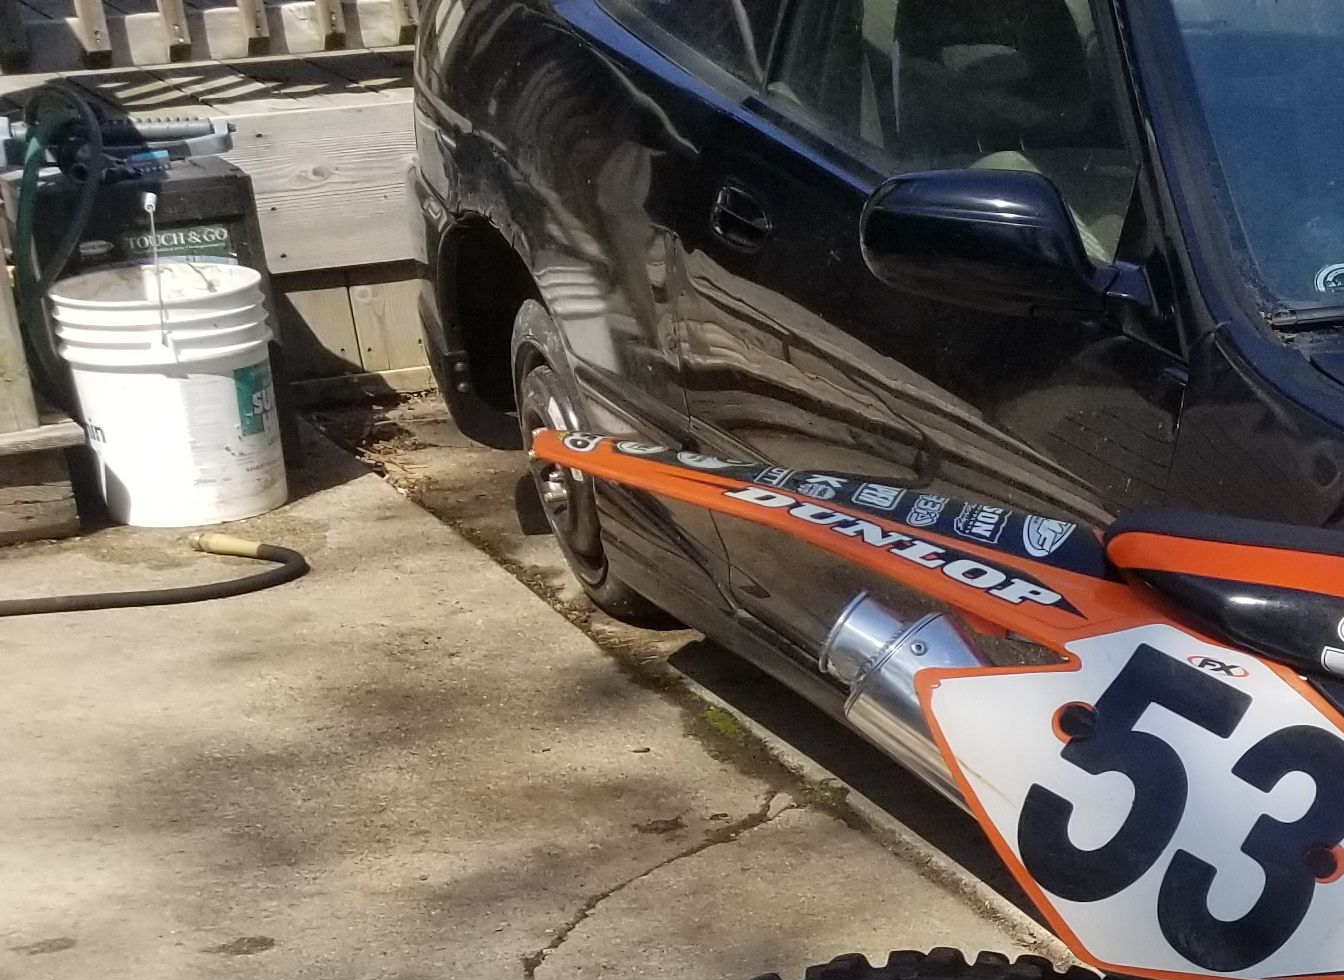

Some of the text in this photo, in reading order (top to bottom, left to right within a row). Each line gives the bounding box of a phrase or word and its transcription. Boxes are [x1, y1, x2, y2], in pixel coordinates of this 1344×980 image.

[188, 230, 201, 244] &
[202, 227, 228, 242] GO
[722, 486, 1063, 606] DUNLOP
[1198, 658, 1241, 676] FX
